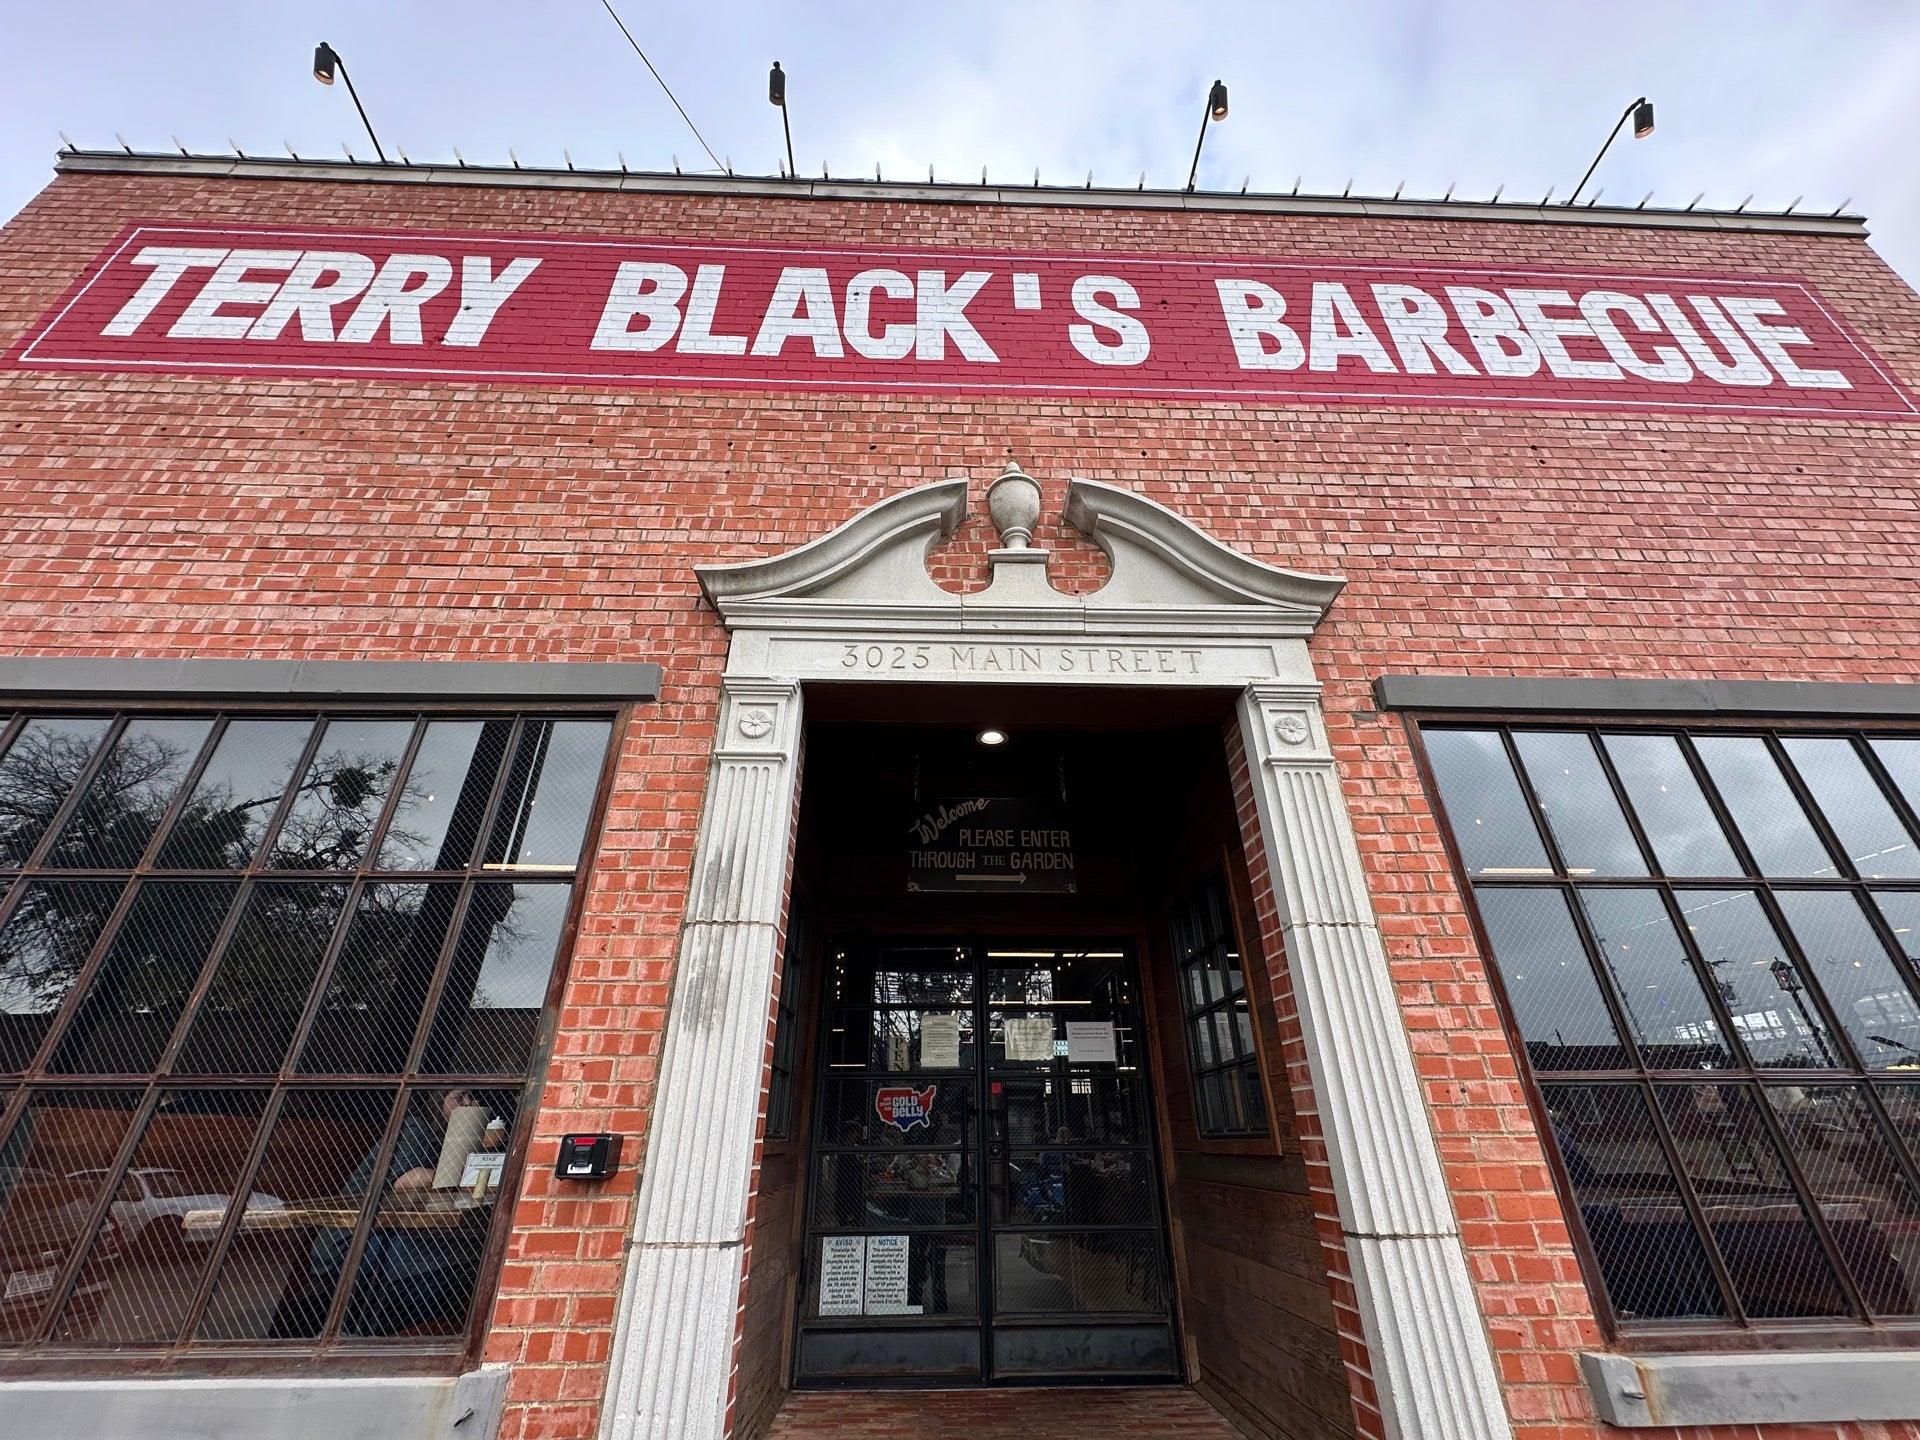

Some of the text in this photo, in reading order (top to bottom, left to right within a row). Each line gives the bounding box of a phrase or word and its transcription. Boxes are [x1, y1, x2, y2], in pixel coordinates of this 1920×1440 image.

[101, 246, 1854, 390] TERRY BLACK'S BARBECUE
[841, 645, 1202, 673] 3025 MAIN STREET
[909, 797, 990, 845] Welcome
[959, 829, 1071, 848] PLEASE ENTER
[909, 850, 1074, 870] THROUGH THE GARDEN
[893, 1037, 904, 1071] PEN
[892, 1096, 918, 1107] GOLD
